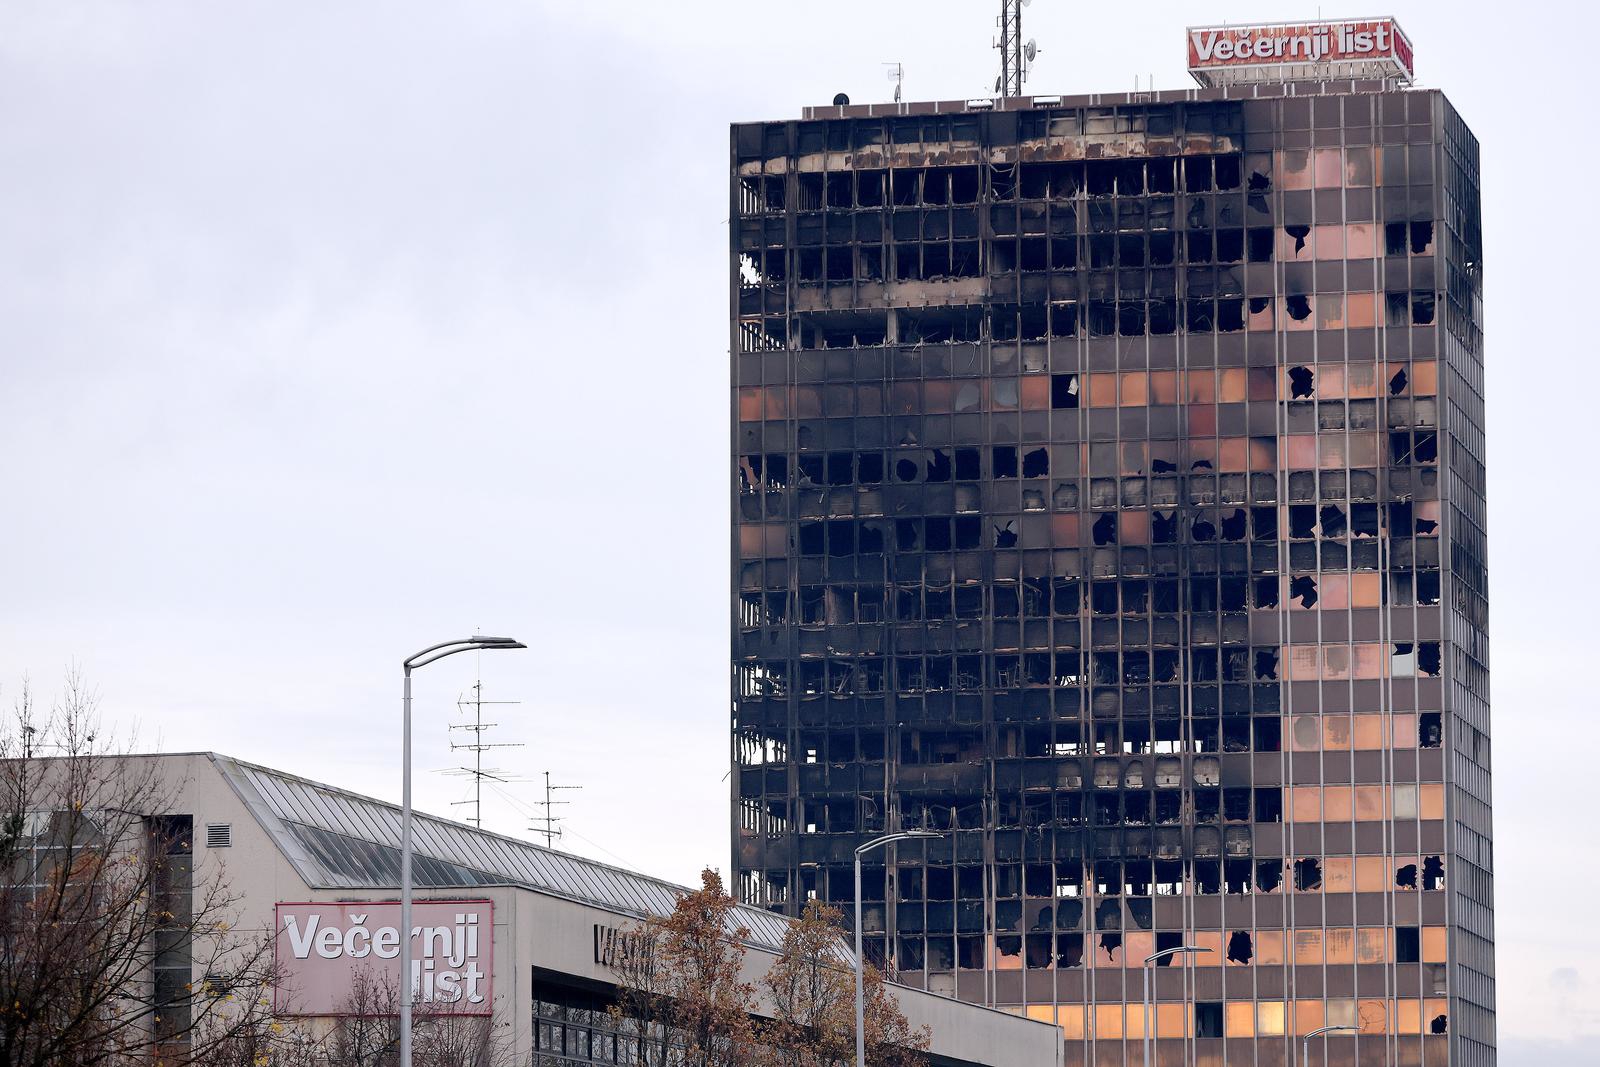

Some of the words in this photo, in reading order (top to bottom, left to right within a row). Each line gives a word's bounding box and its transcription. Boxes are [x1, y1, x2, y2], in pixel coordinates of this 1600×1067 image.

[1191, 27, 1328, 61] Večernji
[1338, 25, 1389, 54] list
[411, 959, 484, 1004] list
